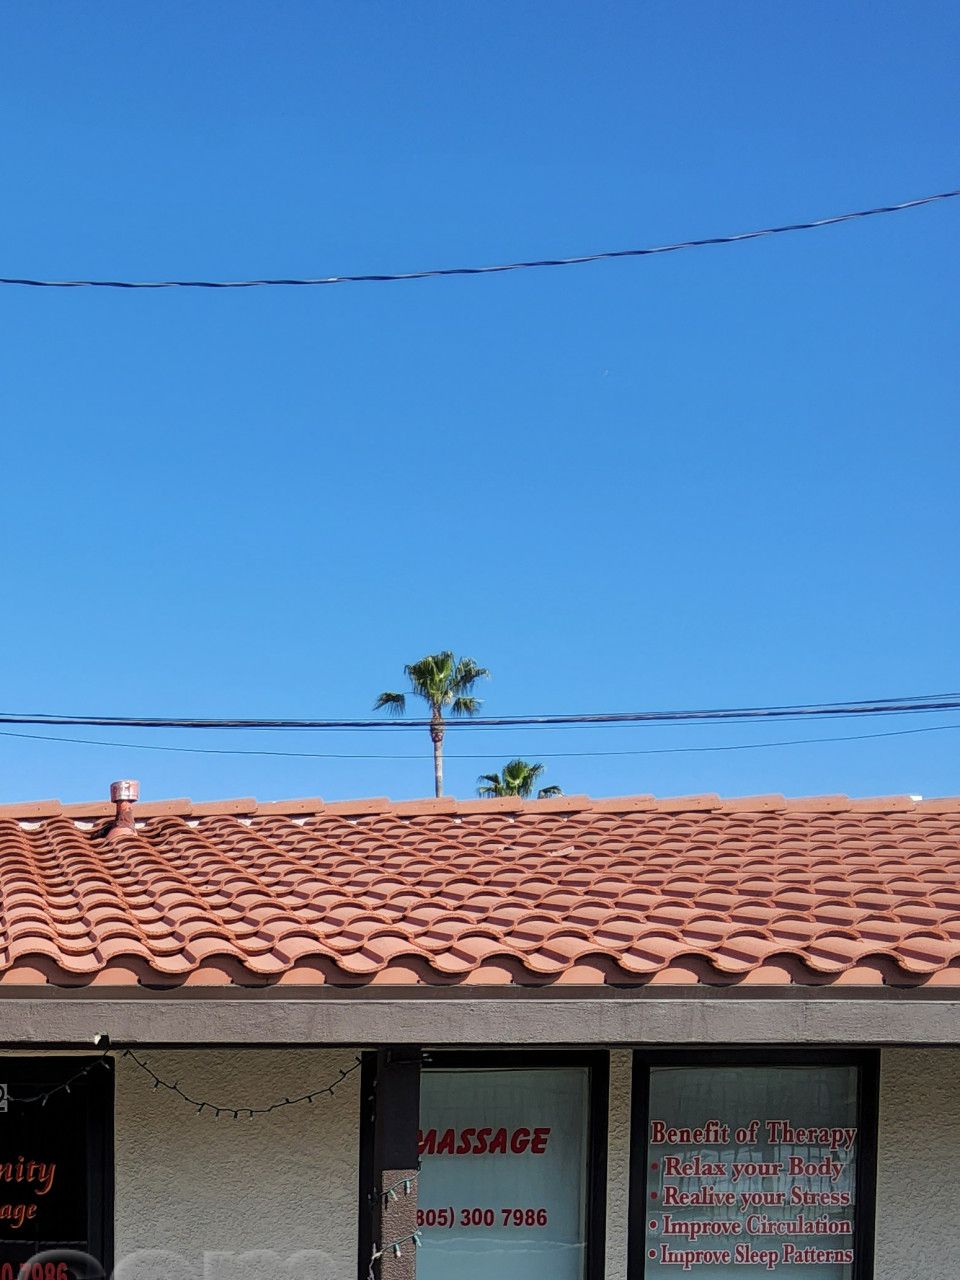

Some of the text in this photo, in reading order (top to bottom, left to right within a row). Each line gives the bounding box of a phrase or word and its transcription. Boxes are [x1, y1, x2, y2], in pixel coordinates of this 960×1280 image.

[417, 1127, 551, 1155] MASSAGE
[650, 1120, 857, 1149] Benefit of Therapy
[664, 1156, 844, 1182] Relax your Body
[663, 1185, 850, 1212] Realive your Stress
[416, 1207, 547, 1228] 805) 300 7986
[662, 1214, 852, 1241] Improve Circulation
[660, 1244, 854, 1270] Improve Sleep Patterns
